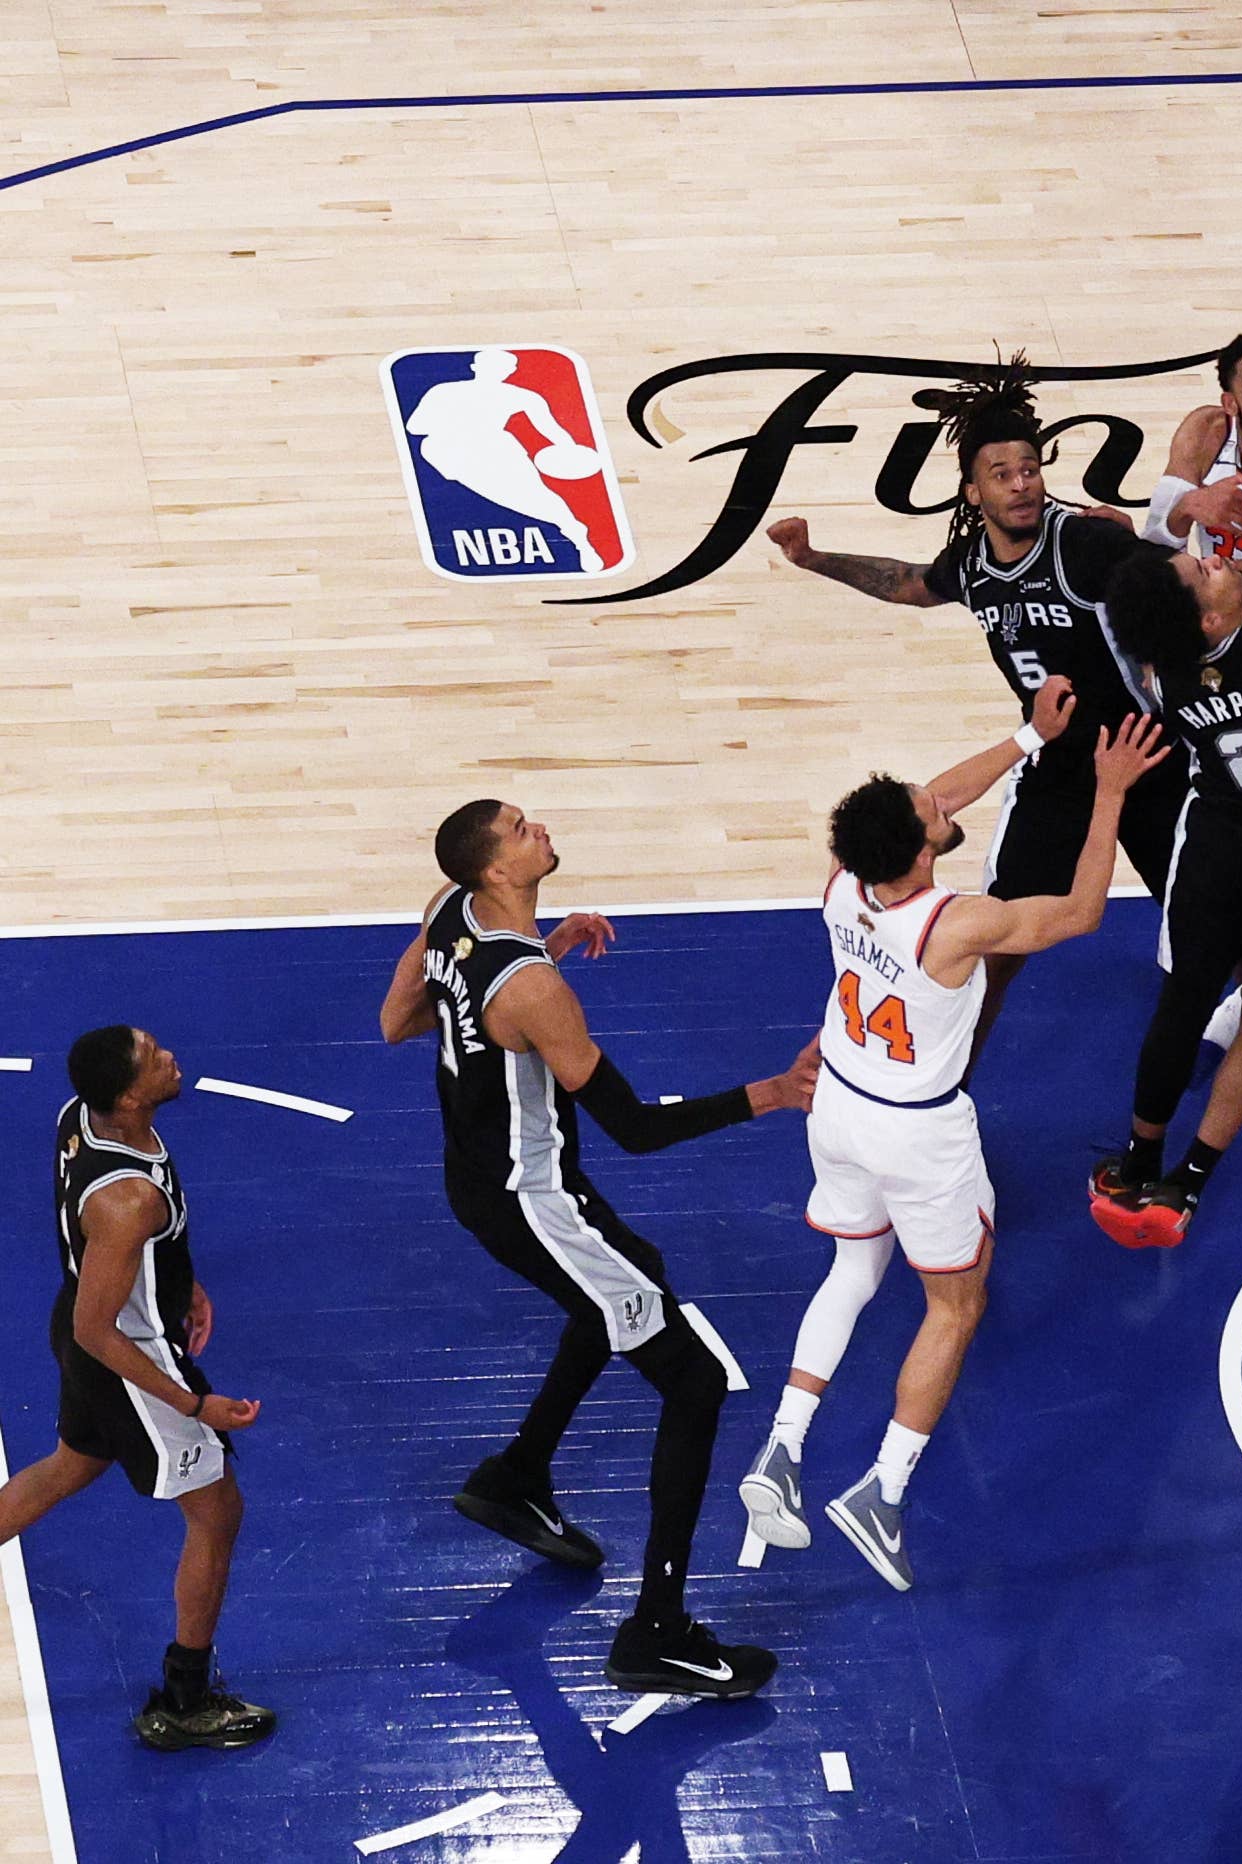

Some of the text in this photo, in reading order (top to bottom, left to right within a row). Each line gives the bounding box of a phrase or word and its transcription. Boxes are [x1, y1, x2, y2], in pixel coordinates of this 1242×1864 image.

[453, 527, 554, 567] NBA
[1010, 651, 1048, 690] 5
[834, 924, 904, 984] SHAMET
[838, 969, 915, 1064] 44
